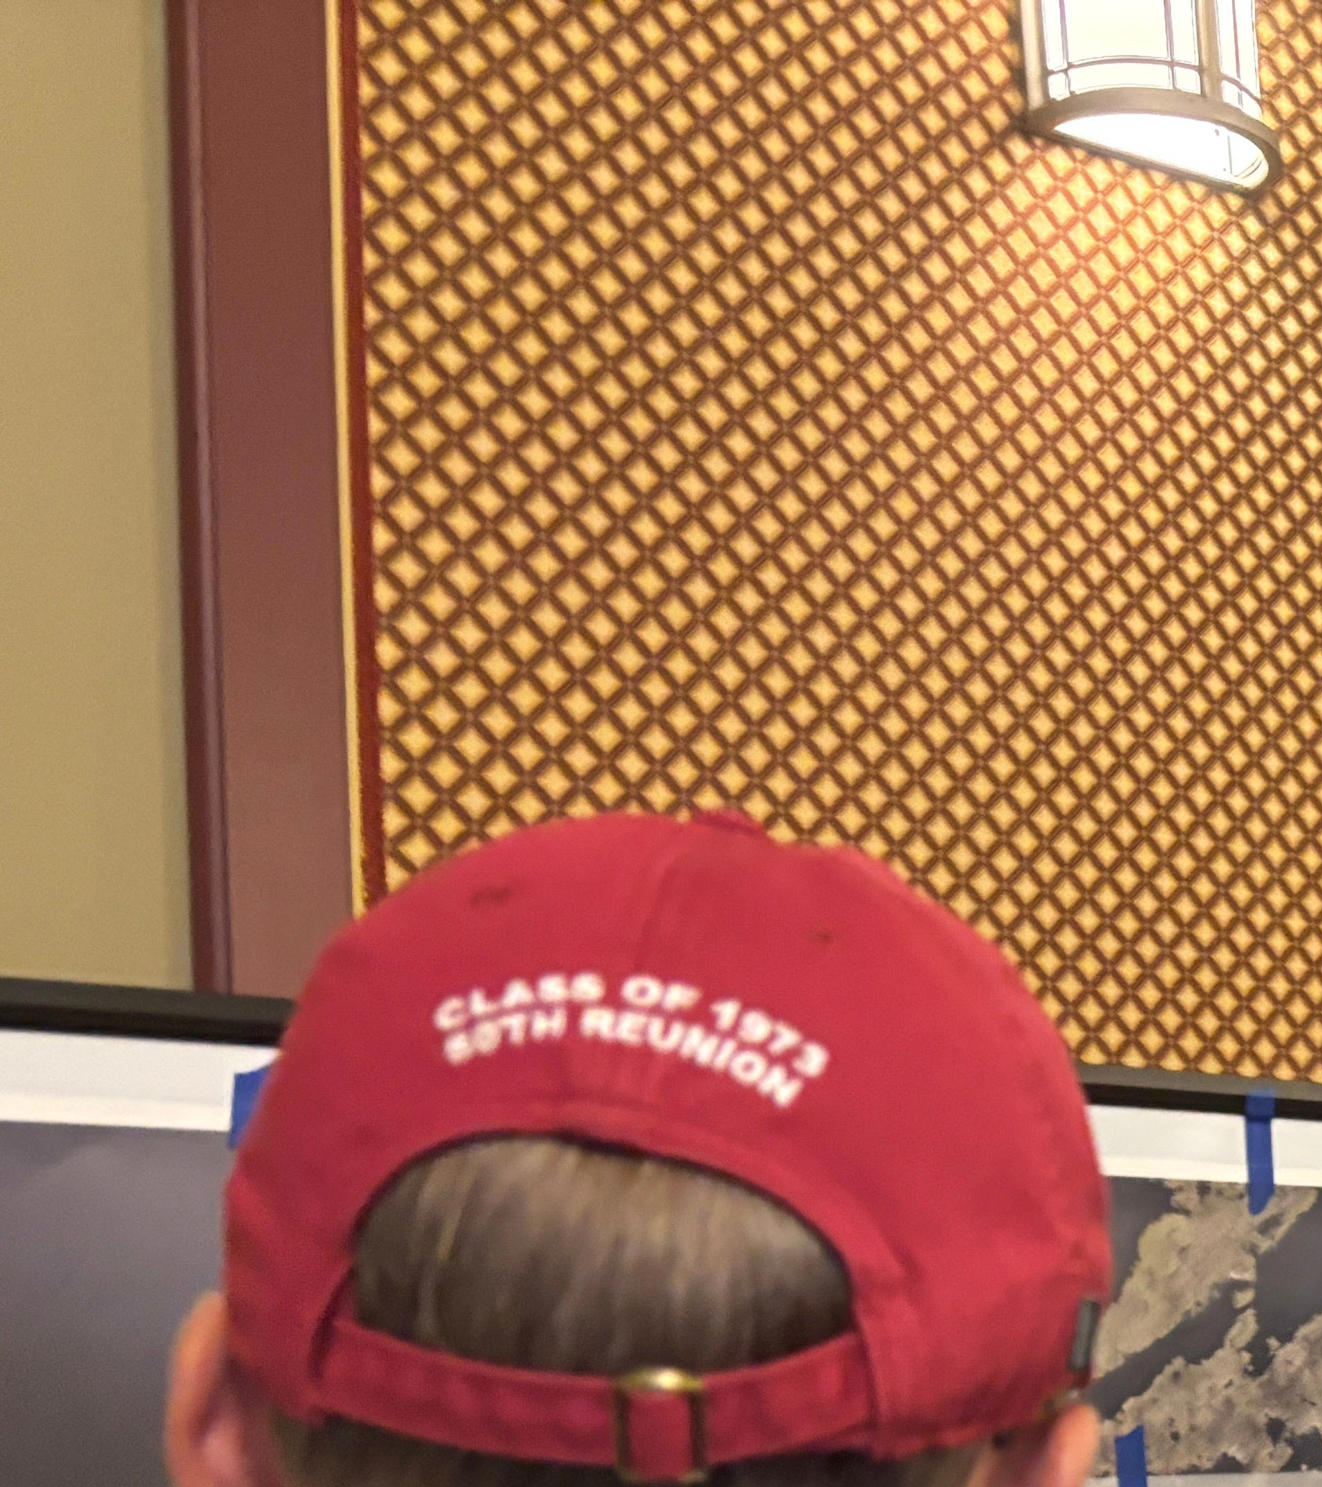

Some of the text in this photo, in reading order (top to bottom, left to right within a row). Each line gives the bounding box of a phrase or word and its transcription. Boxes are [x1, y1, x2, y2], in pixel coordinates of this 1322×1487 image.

[433, 972, 830, 1078] CLASS OF 1973
[579, 1006, 803, 1108] REUNION
